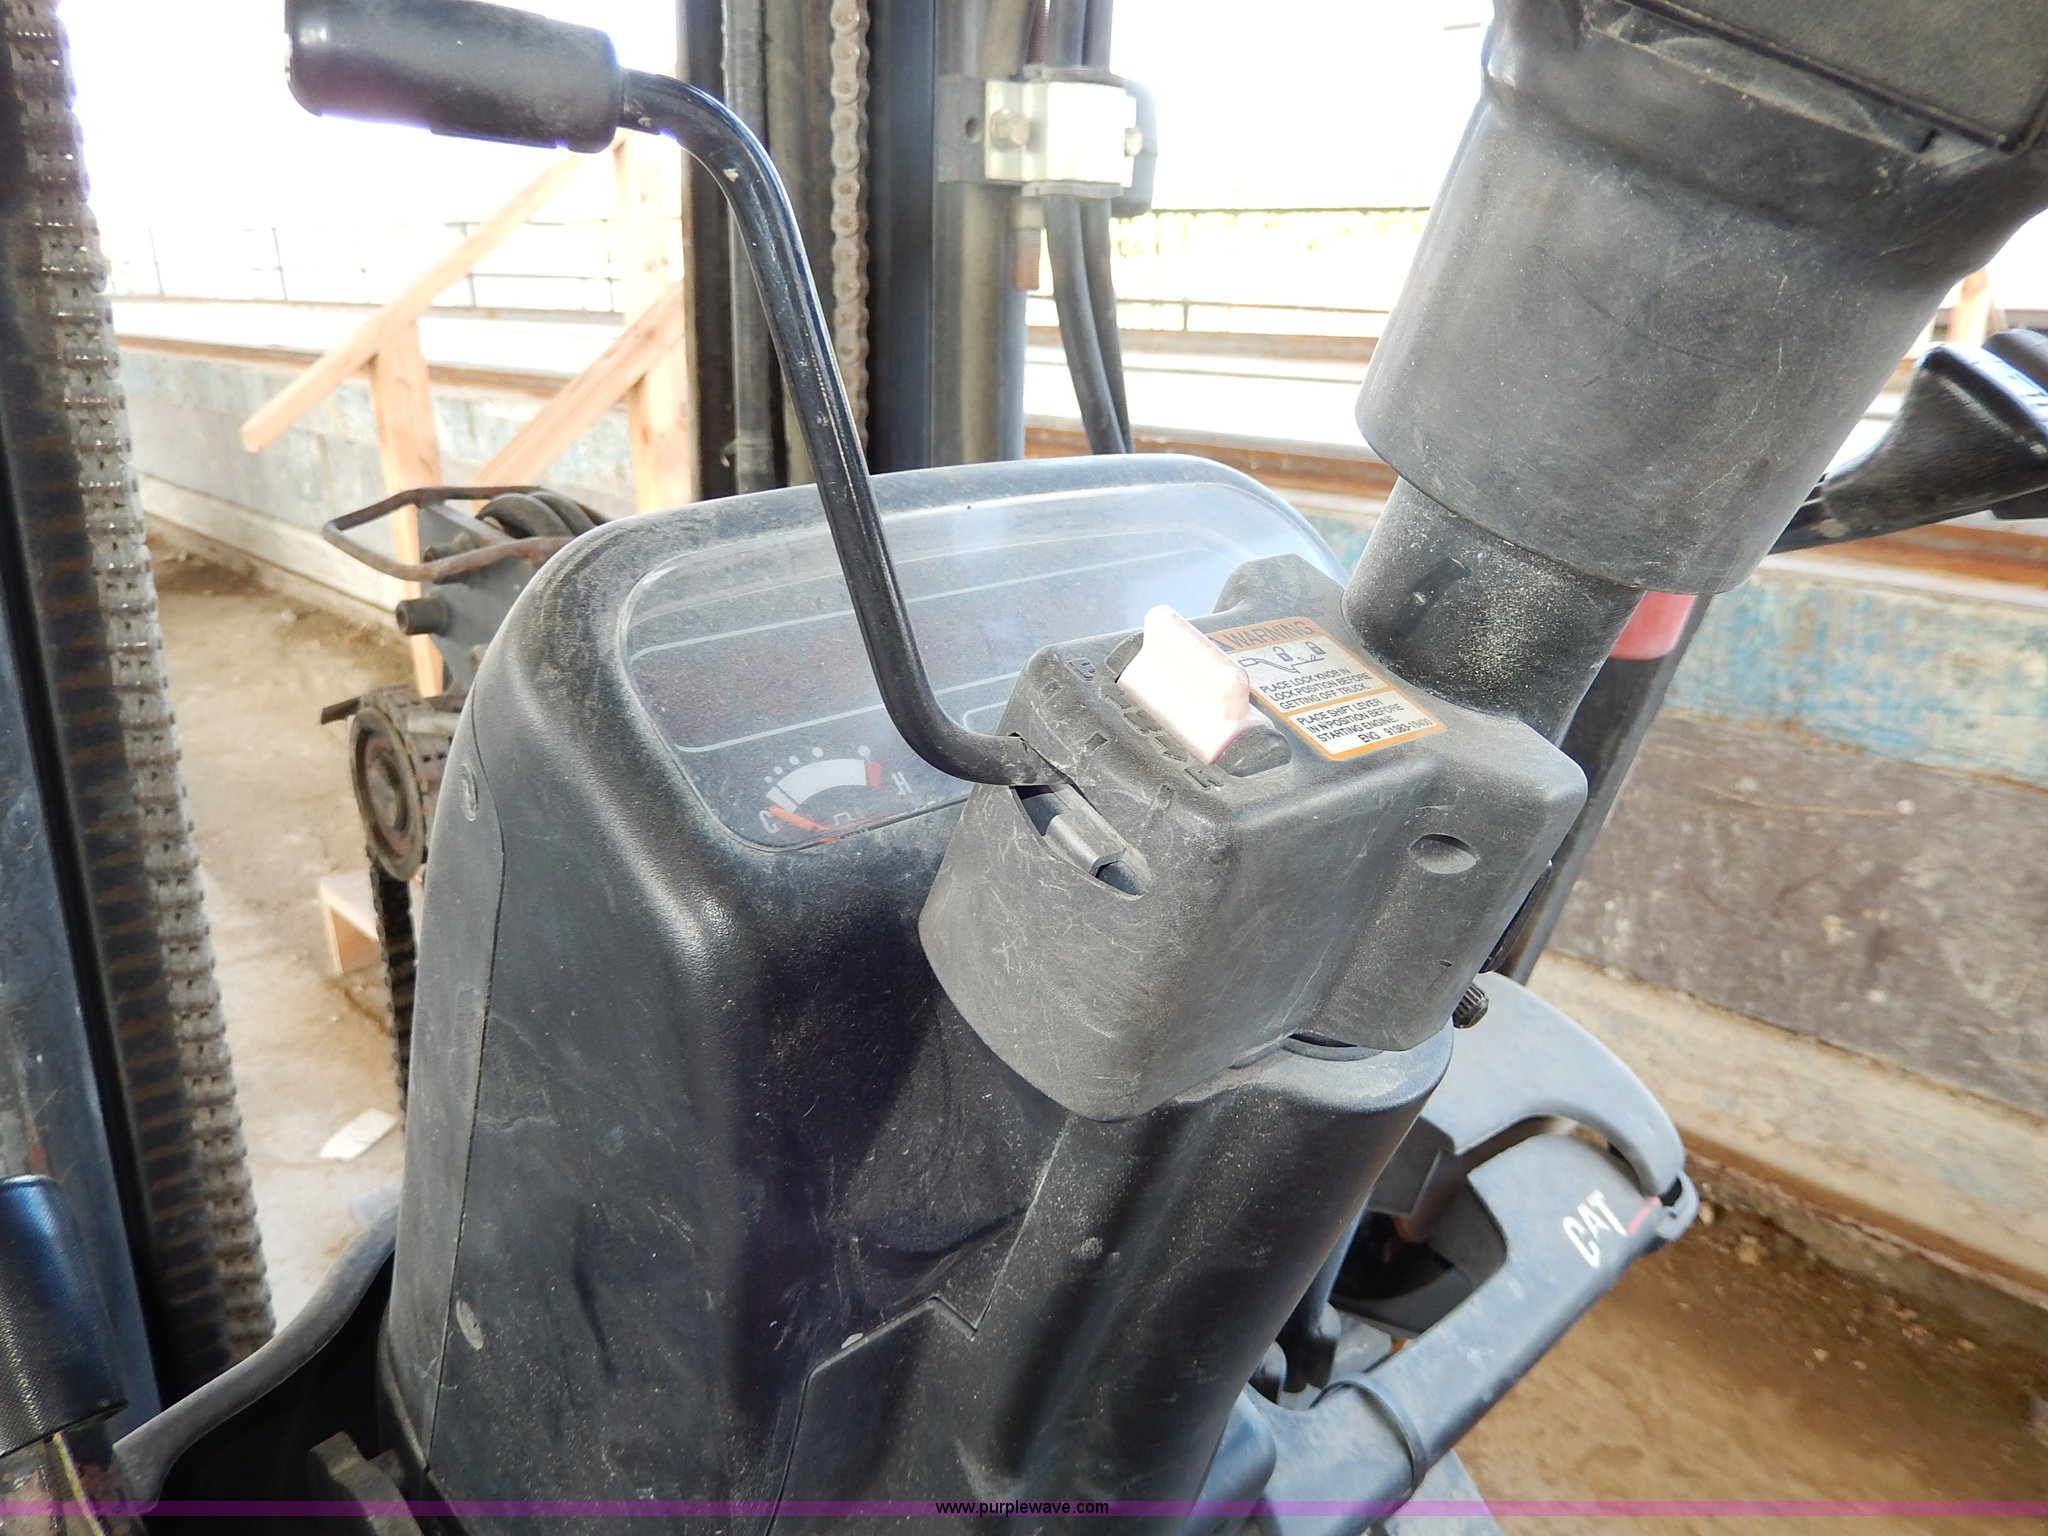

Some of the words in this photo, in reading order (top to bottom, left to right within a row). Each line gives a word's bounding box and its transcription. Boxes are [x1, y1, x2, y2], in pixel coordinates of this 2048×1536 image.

[1231, 621, 1314, 647] WARNING
[1259, 680, 1292, 693] PLACE
[1290, 675, 1314, 685] LOCK
[1315, 669, 1341, 681] KNOB
[1269, 690, 1298, 701] LOCK
[1297, 681, 1340, 695] POSITION
[1336, 672, 1372, 685] BEFORE
[1280, 694, 1322, 709] GETTING
[1319, 689, 1340, 700] OFF
[1297, 712, 1329, 725] PLACE
[1327, 705, 1355, 718] SHIFT
[1353, 698, 1383, 711] LEVER
[1307, 725, 1320, 733] IN
[1328, 712, 1372, 730] POSITION
[1368, 703, 1404, 718] BEFORE
[1317, 724, 1365, 742] STARTING
[1358, 731, 1381, 743] ENG
[1562, 1189, 1628, 1269] CAT
